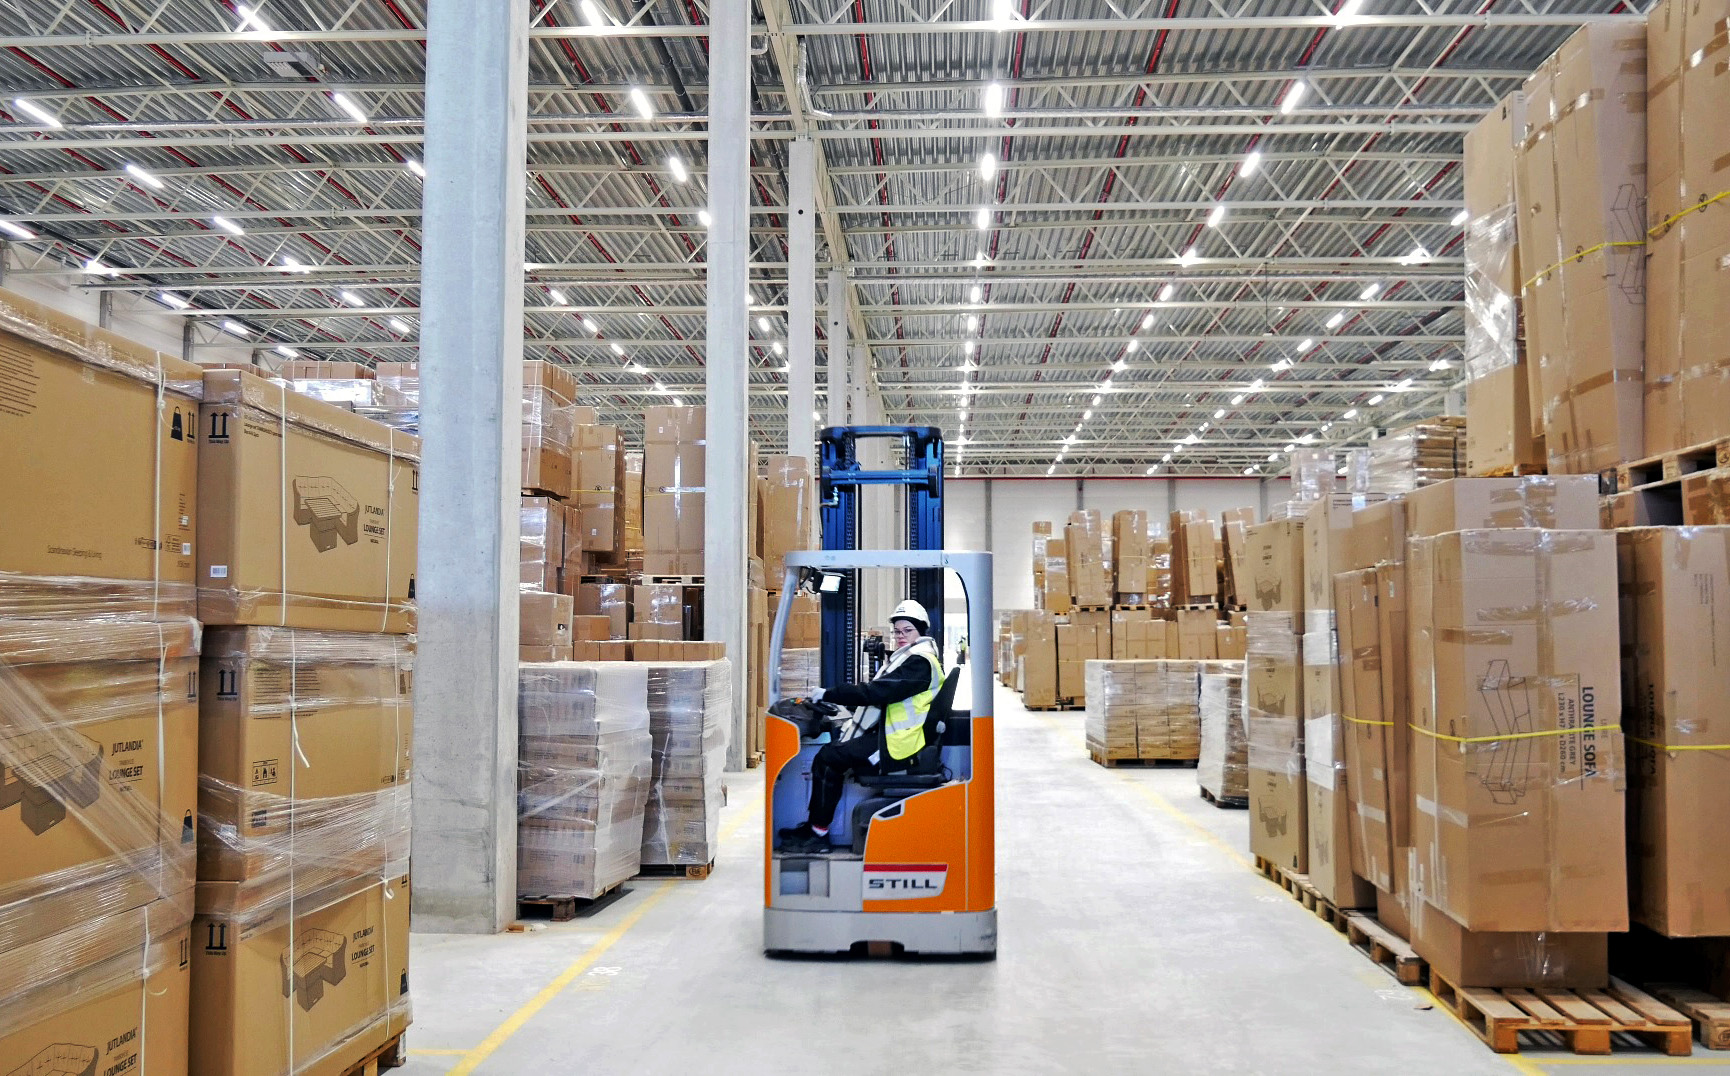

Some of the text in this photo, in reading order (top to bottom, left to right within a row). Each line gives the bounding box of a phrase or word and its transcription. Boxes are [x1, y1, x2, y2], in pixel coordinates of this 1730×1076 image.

[1568, 699, 1576, 744] ANTHRAITE
[1582, 686, 1597, 777] LOUNGE SOFA
[111, 740, 142, 756] JUTLANDIA
[109, 765, 143, 780] LOUNGE SET
[868, 878, 938, 889] STILL
[351, 947, 368, 961] LOUNGE
[106, 1028, 136, 1055] JUTLANDIA
[128, 1053, 137, 1067] SET
